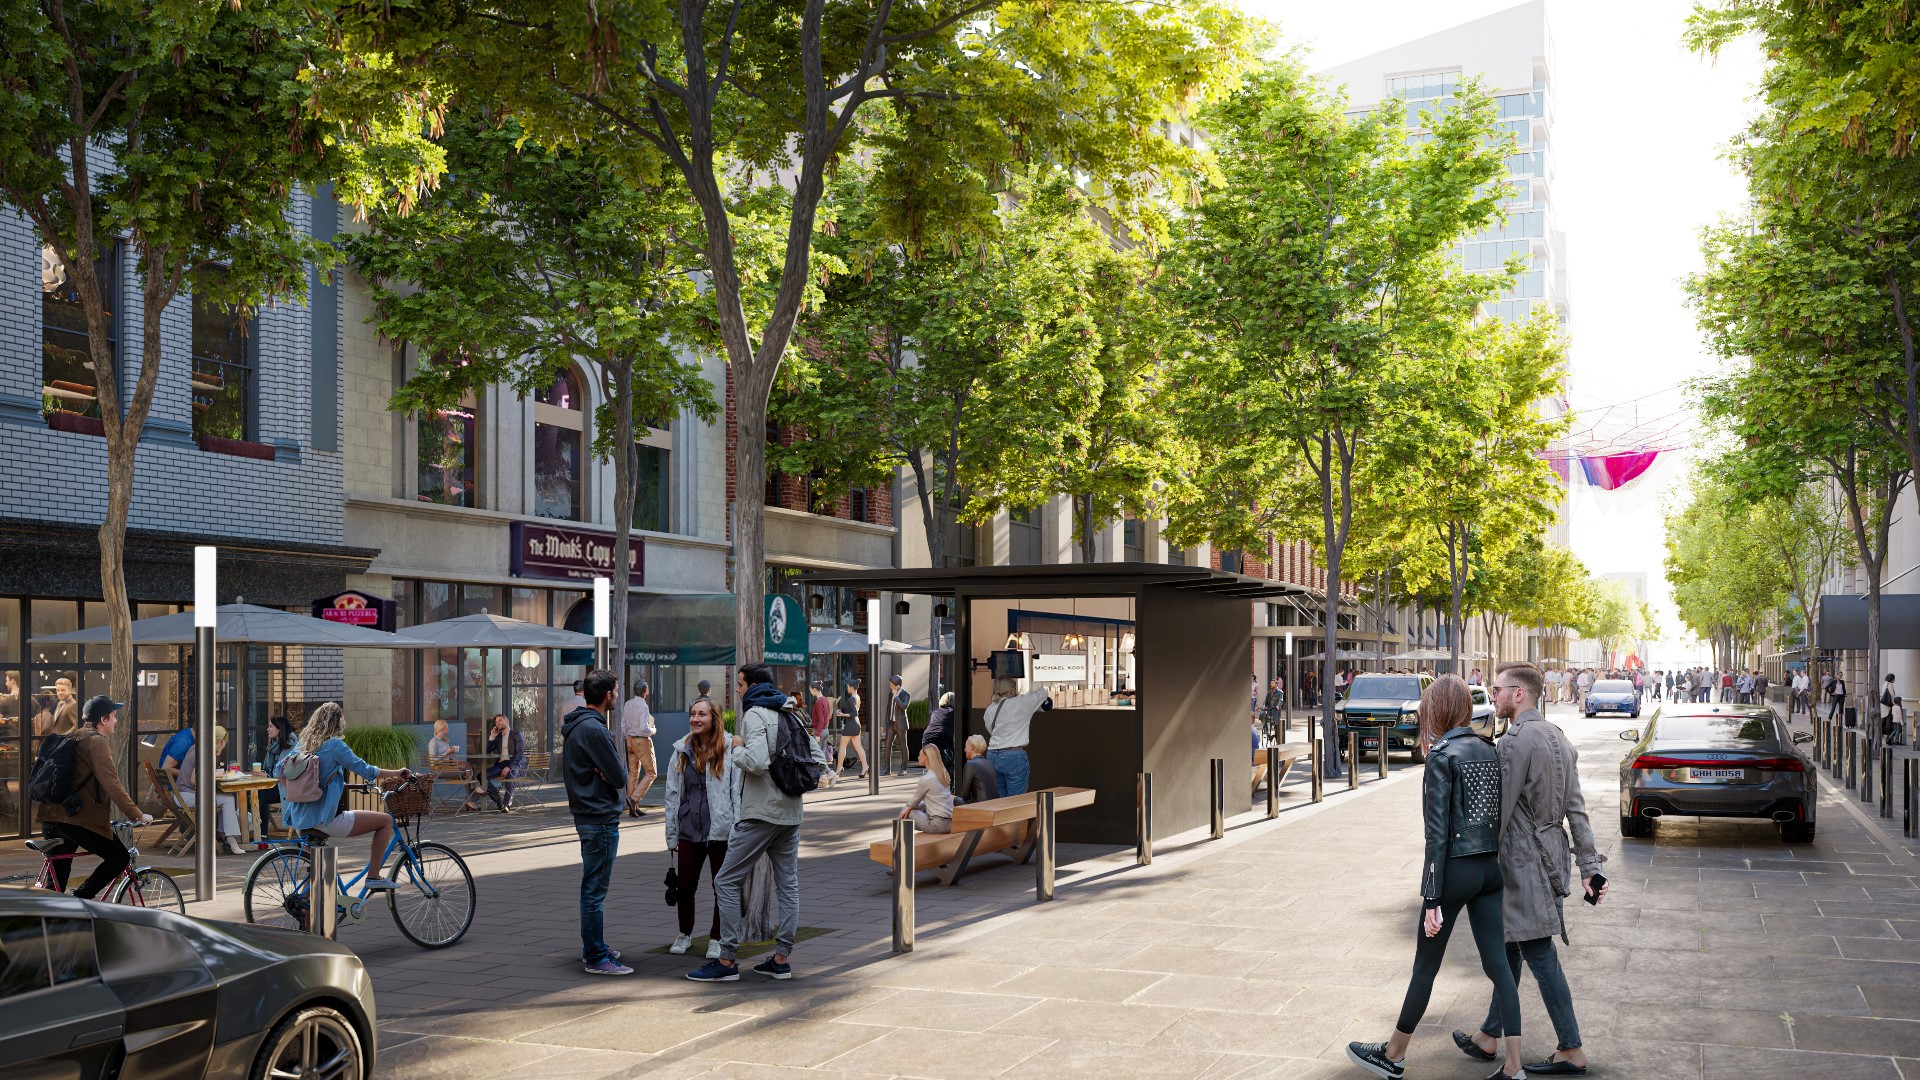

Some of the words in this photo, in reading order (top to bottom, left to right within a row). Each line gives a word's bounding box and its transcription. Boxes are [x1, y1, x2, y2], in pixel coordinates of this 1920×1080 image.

[528, 538, 544, 556] The
[545, 534, 583, 559] Monk's
[586, 540, 610, 567] Copy
